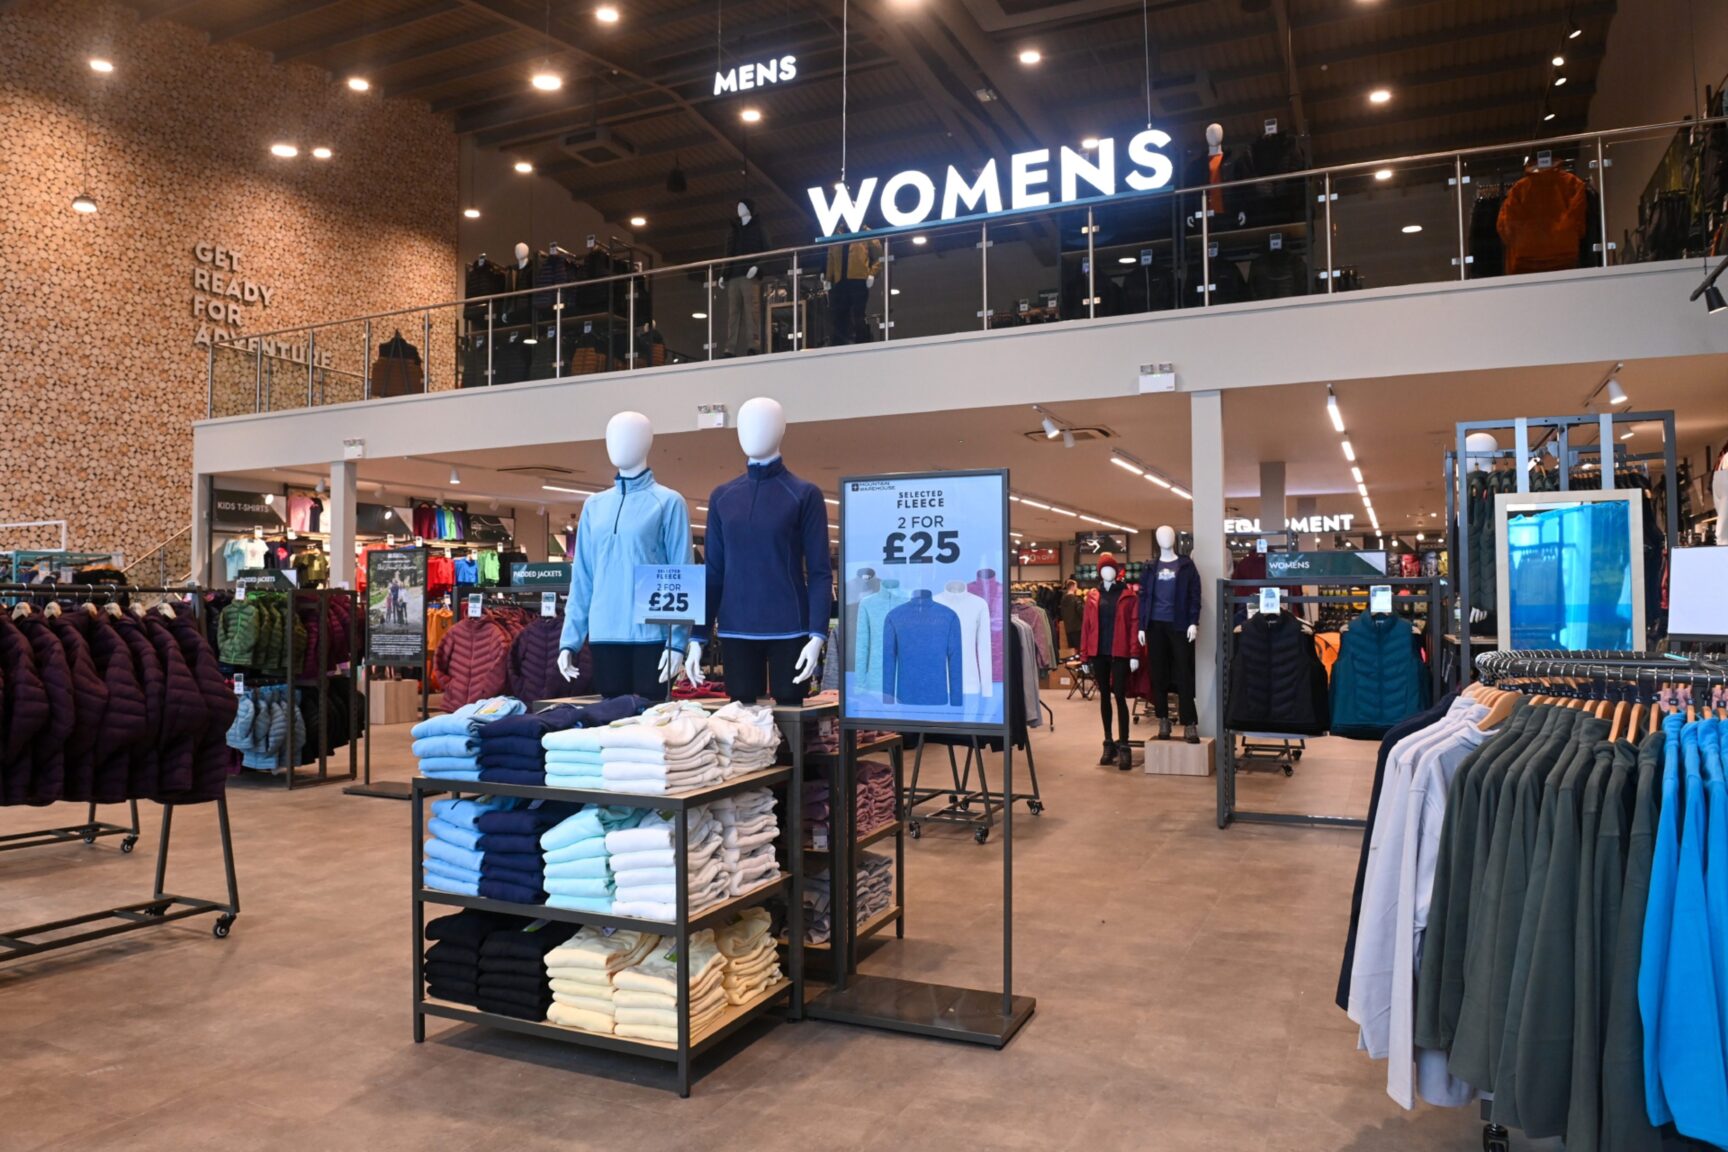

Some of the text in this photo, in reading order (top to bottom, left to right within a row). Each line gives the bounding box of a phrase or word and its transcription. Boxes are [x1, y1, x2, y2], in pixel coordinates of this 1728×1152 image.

[713, 55, 797, 96] MENS
[807, 129, 1174, 238] WOMENS
[195, 241, 242, 271] GET
[194, 267, 274, 307] READY
[194, 294, 242, 326] FOR
[897, 498, 944, 509] FLEECE
[898, 490, 943, 499] SELECTED
[217, 501, 269, 513] KIDS T-SHIRTS
[898, 515, 944, 529] 2 FOR
[1224, 514, 1354, 534] EQMENT
[883, 530, 960, 565] £25
[513, 570, 562, 579] PADDED JACKETS
[1269, 560, 1310, 570] WOMENS
[657, 583, 681, 591] 2 FOR
[648, 591, 689, 612] £25
